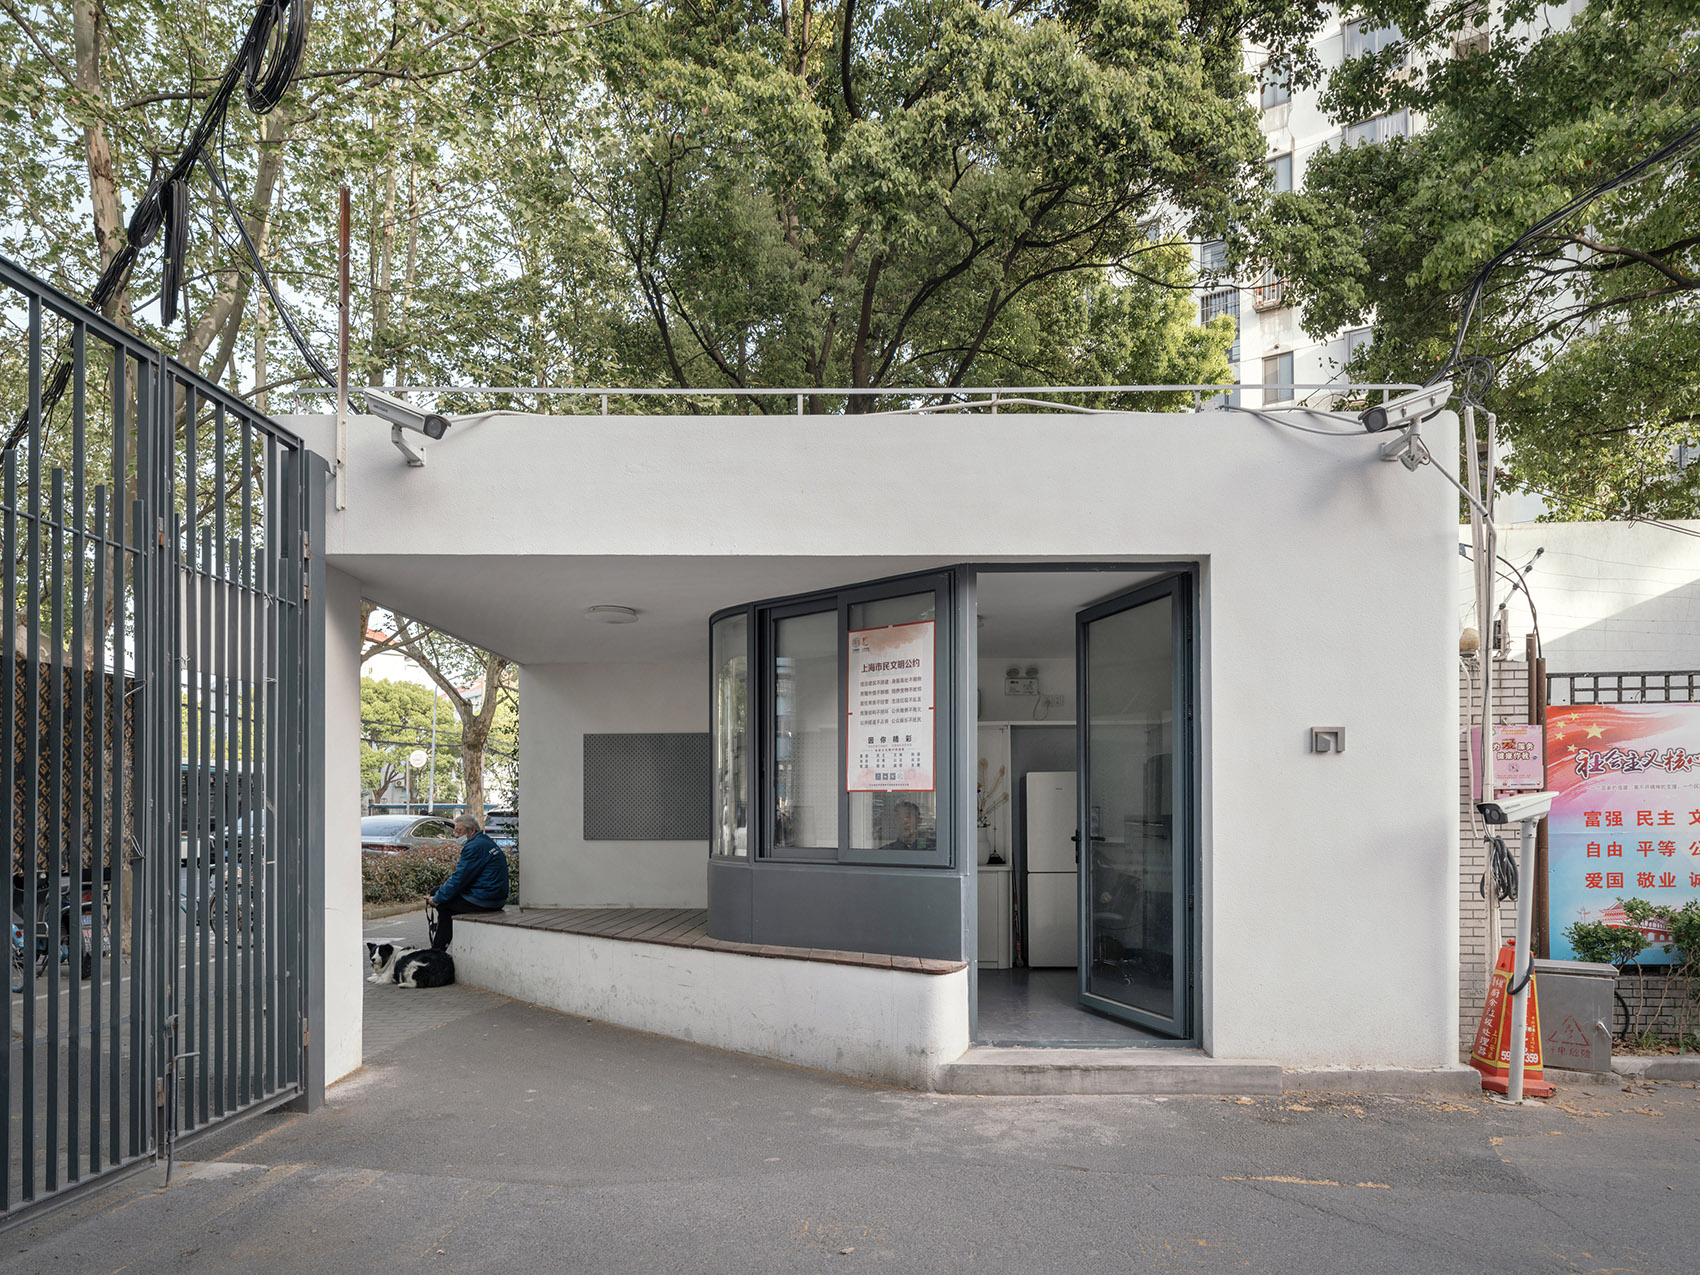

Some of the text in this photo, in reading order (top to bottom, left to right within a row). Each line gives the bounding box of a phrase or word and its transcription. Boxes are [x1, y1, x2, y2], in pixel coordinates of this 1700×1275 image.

[861, 658, 920, 673] 上海市民文明公约
[1584, 810, 1623, 828] 富强
[1636, 810, 1676, 827] 民主
[1586, 841, 1622, 858] 自由
[1636, 841, 1676, 858] 平等
[1585, 872, 1624, 889] 爱国
[1636, 872, 1677, 889] 敬业
